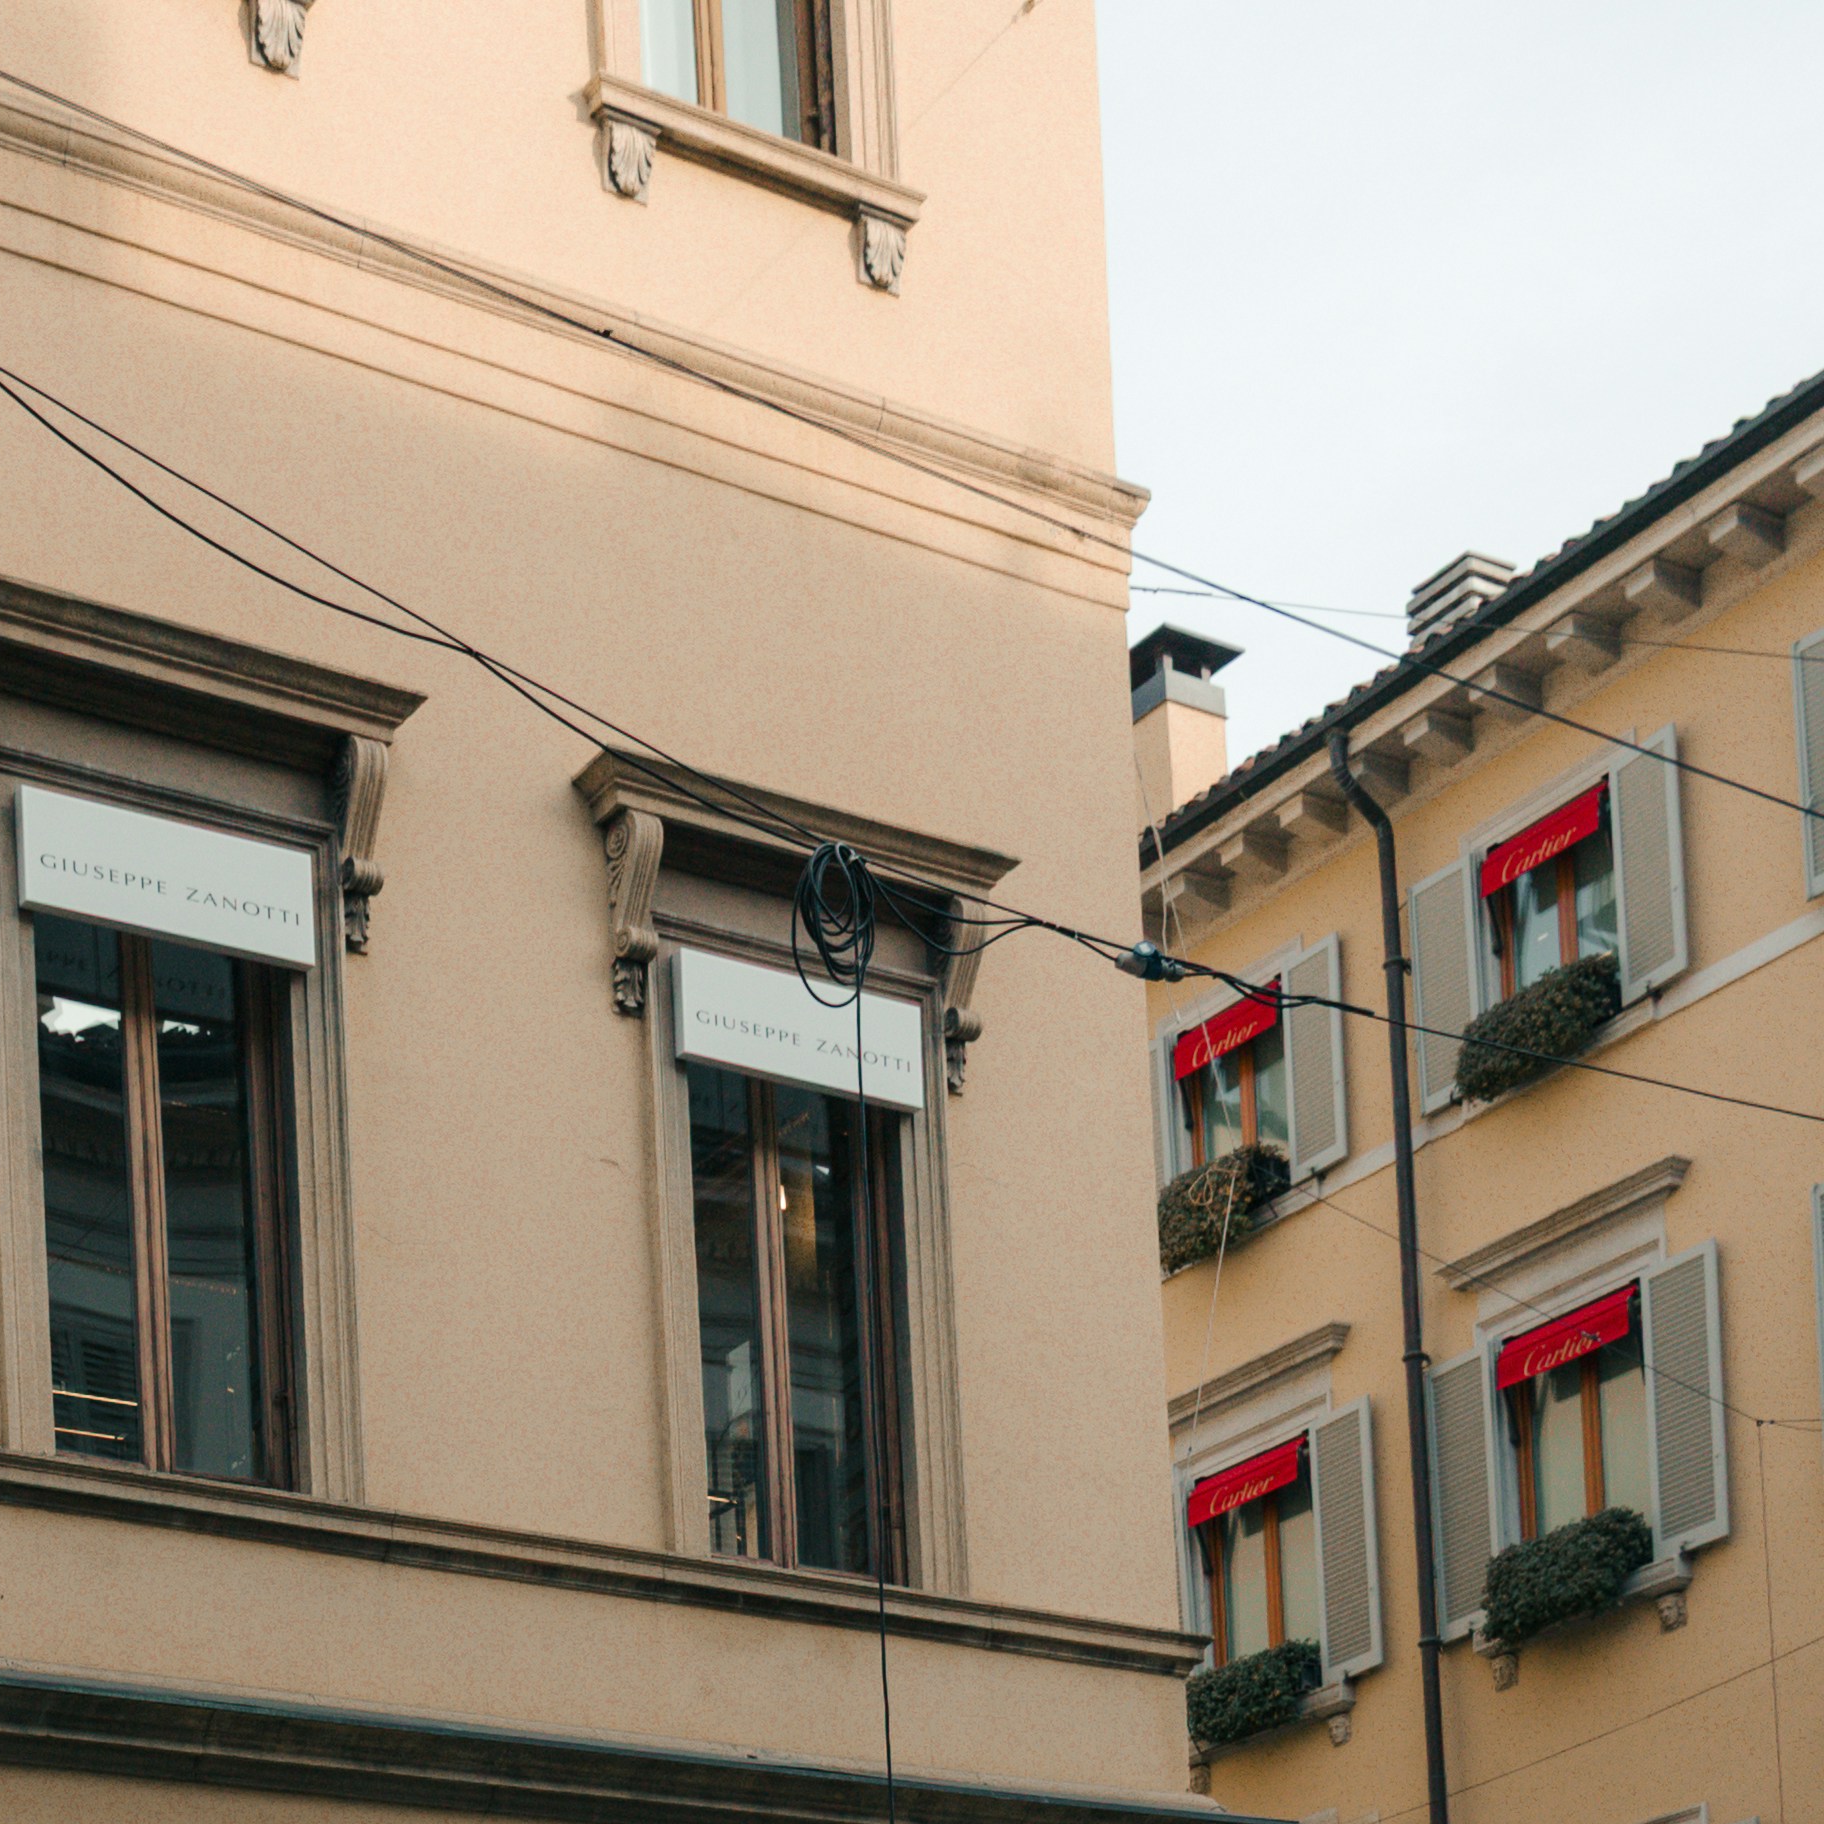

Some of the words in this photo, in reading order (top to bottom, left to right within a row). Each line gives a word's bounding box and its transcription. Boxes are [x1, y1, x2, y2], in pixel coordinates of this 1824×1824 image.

[1501, 826, 1577, 883] Cartier
[40, 853, 167, 895] GIUSEPPE
[186, 886, 300, 926] ZANOTTI
[695, 1009, 801, 1047] GIUSEPPE
[816, 1038, 912, 1073] ZANOTTI
[1192, 1021, 1258, 1068] Cartier
[1523, 1331, 1600, 1377] Cartier
[1209, 1475, 1274, 1515] Cartier
